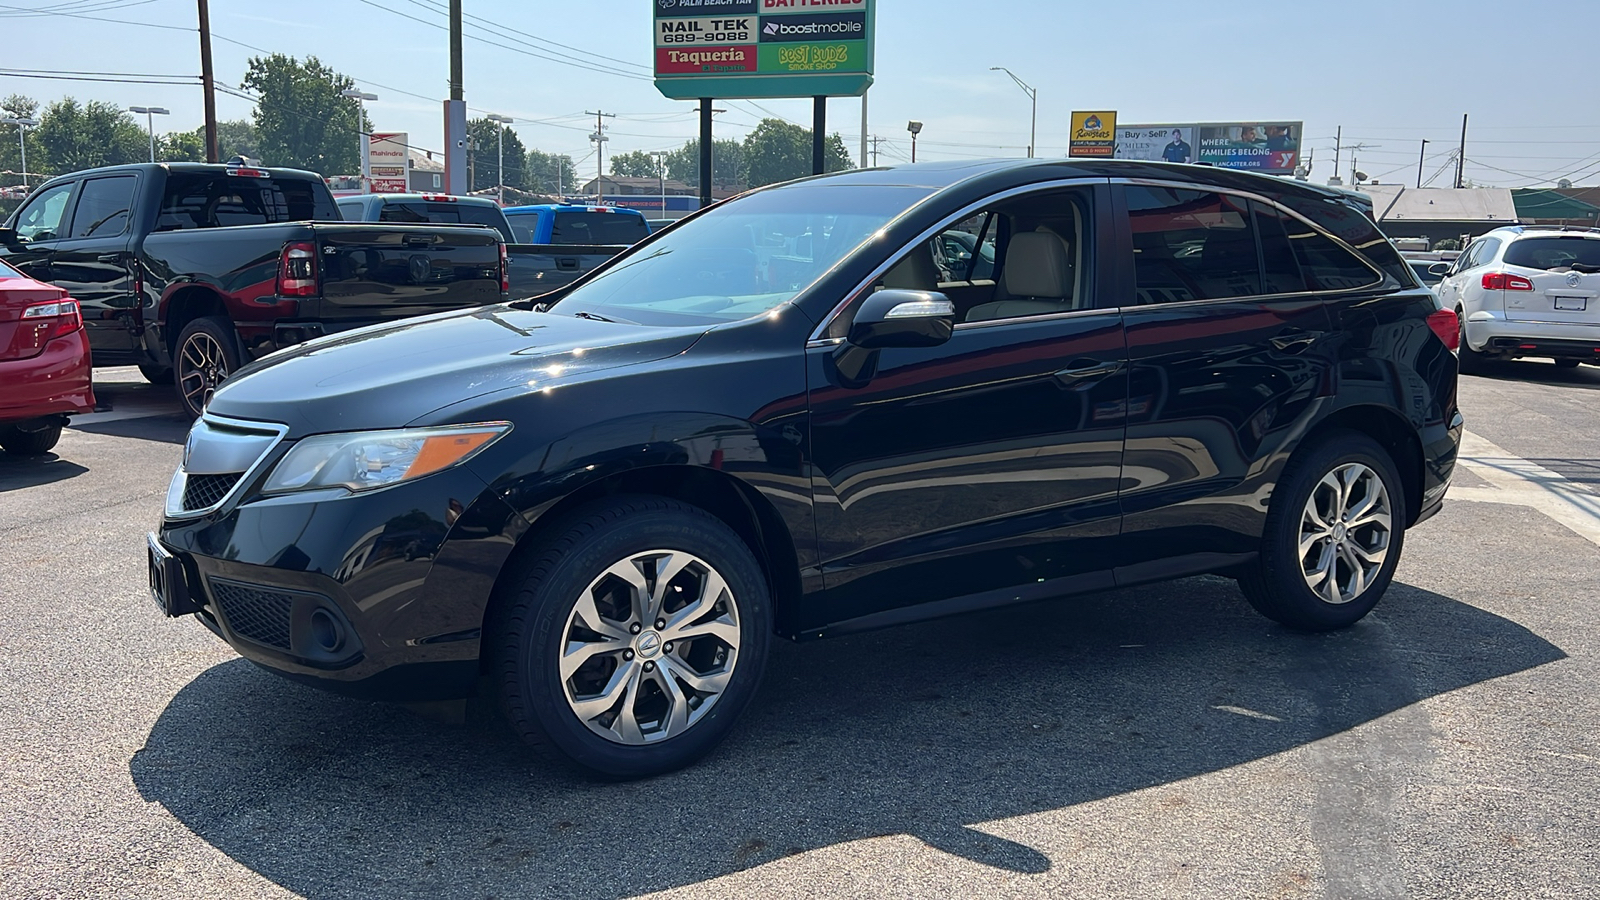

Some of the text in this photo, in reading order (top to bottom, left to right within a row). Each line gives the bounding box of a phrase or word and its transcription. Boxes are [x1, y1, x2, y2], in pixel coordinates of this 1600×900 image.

[662, 19, 749, 33] NAIL TEK
[780, 21, 862, 34] boostmobile
[664, 32, 748, 43] 689-9088
[788, 62, 837, 71] SMOKE SHOP
[1076, 128, 1110, 139] Roosters
[1125, 131, 1141, 139] Buy
[1149, 130, 1168, 138] Sell?
[1238, 148, 1273, 156] BELONG.
